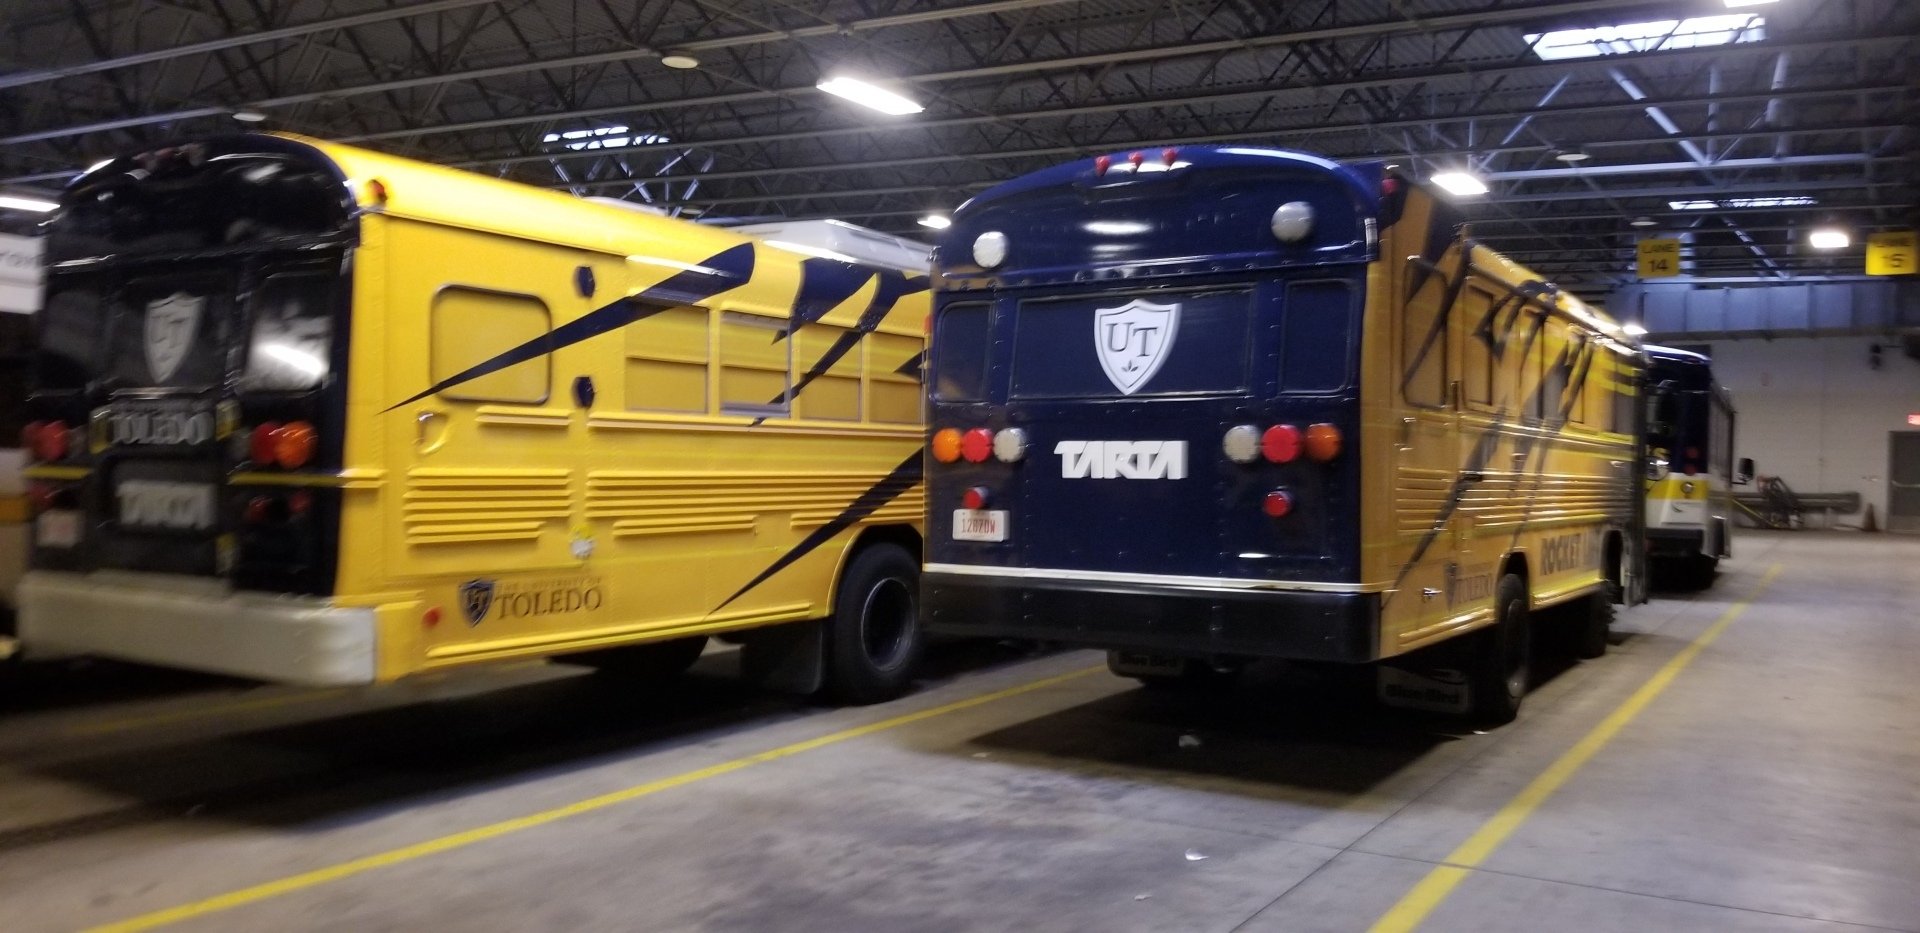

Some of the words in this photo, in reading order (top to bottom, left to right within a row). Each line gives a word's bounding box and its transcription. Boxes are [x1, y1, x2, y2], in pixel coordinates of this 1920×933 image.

[1641, 242, 1676, 254] LANE
[1647, 258, 1669, 273] 14
[1105, 321, 1159, 358] UT
[1054, 440, 1188, 480] TARTA
[1540, 533, 1582, 577] ROCKET
[494, 586, 603, 620] TOLEDO
